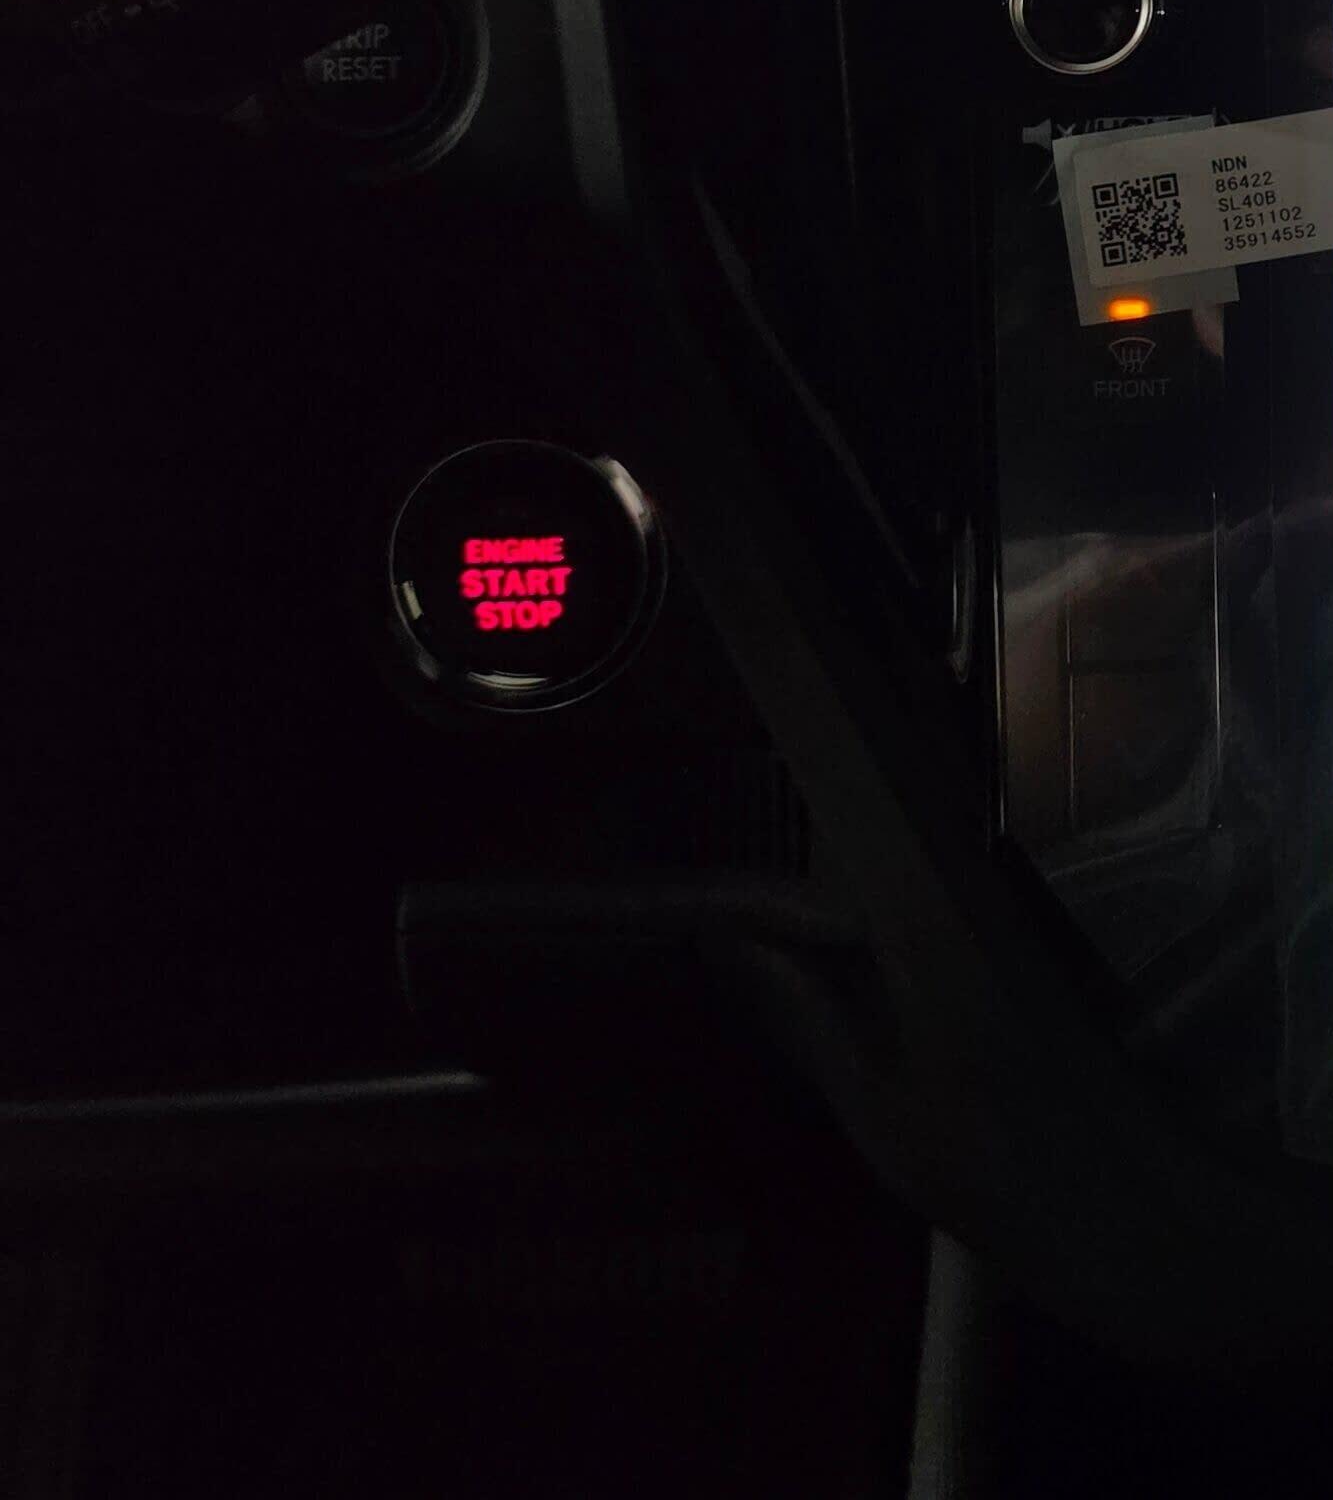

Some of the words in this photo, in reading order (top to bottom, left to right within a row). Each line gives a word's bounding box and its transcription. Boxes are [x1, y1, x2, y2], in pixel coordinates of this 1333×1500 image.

[1211, 156, 1248, 174] NDN
[1215, 171, 1274, 193] 86422
[1217, 190, 1276, 213] SL40B
[1222, 206, 1303, 232] 1251102
[1224, 223, 1317, 251] 35914552
[1094, 379, 1171, 399] FRONT
[464, 538, 565, 564] ENGINE
[460, 567, 573, 598] START
[475, 600, 564, 630] STOP
